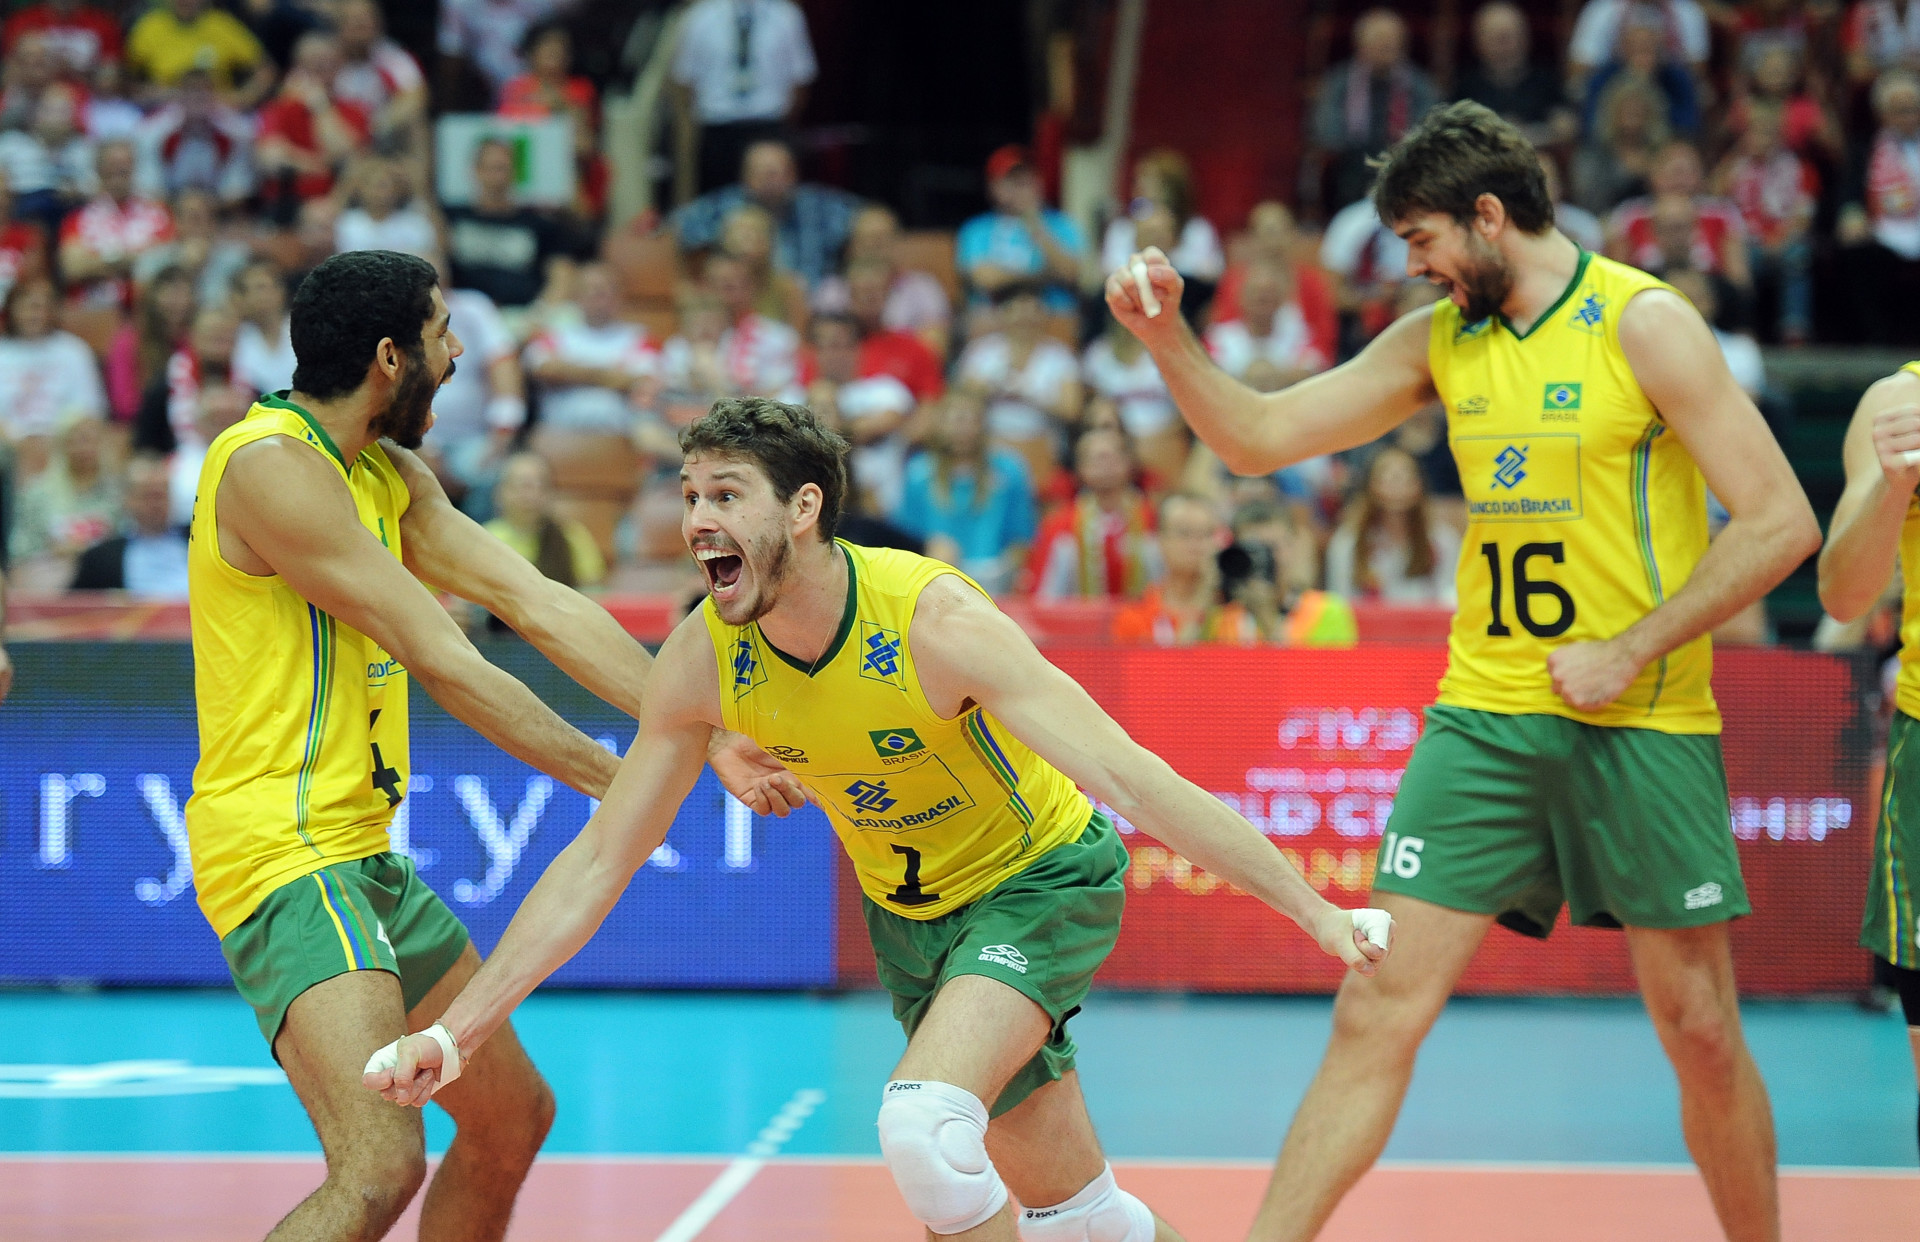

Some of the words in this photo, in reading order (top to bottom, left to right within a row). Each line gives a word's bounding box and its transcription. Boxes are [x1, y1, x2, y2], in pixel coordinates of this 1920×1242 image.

[1520, 498, 1574, 513] BRASIL
[1481, 541, 1576, 637] 16
[882, 750, 930, 766] BRASIL
[878, 819, 903, 829] DO
[900, 795, 965, 827] BRASIL
[1380, 831, 1425, 879] 16
[886, 843, 941, 906] 1
[977, 953, 1028, 974] OLYMPIKUS
